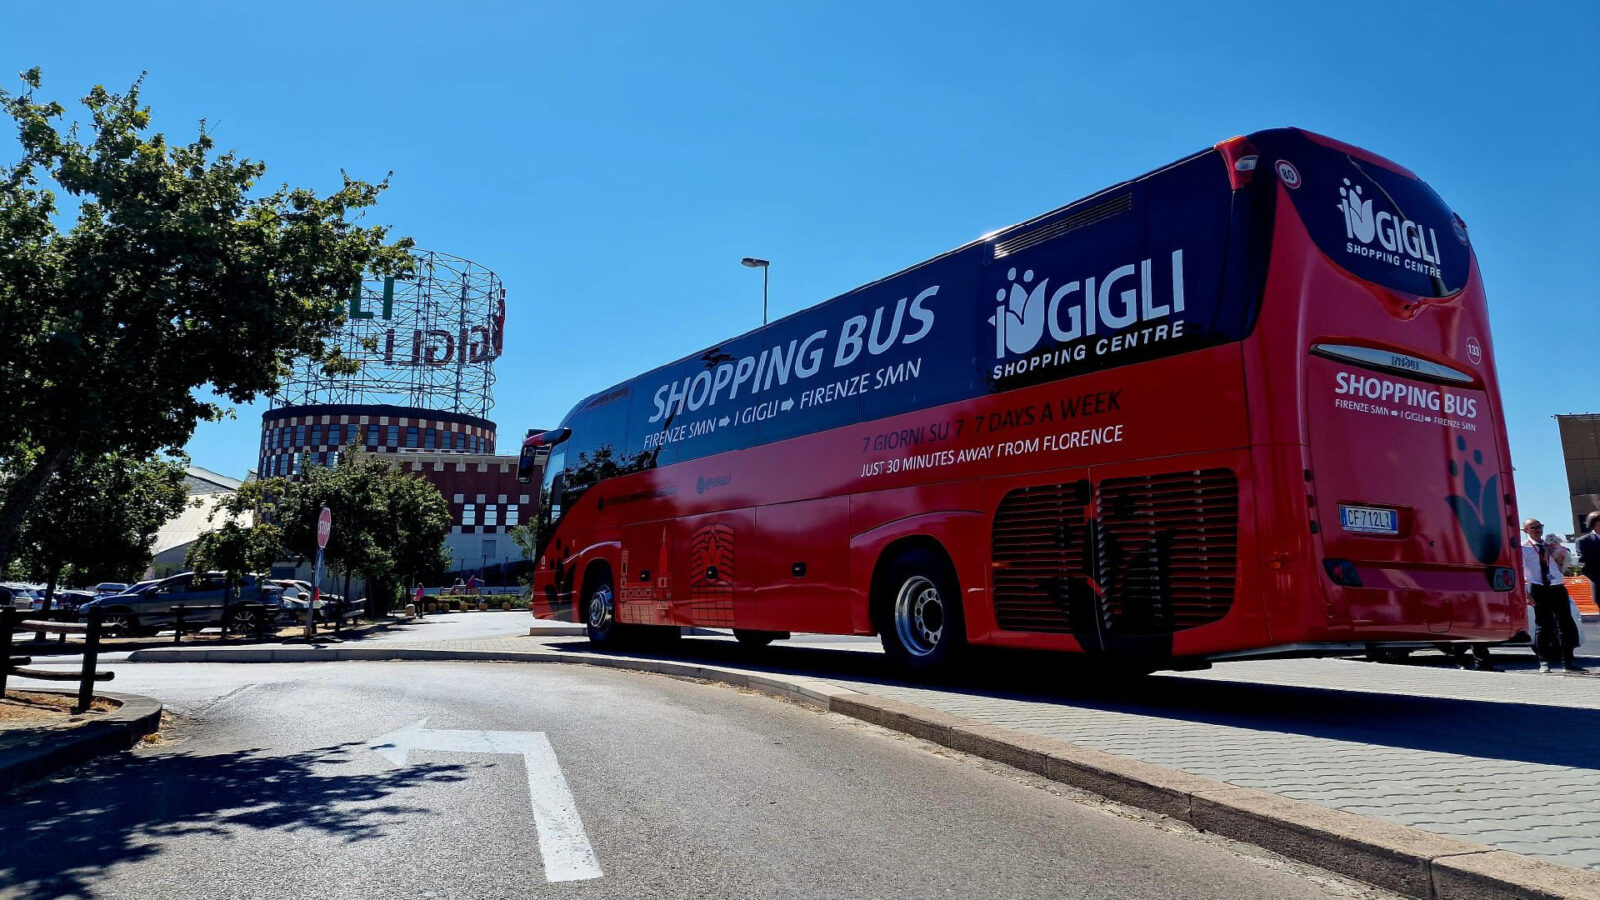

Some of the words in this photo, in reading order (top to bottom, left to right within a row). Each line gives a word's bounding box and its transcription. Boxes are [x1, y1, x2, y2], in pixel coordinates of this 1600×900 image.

[1282, 168, 1294, 181] 80
[1346, 242, 1400, 266] SHOPPING
[1404, 258, 1441, 279] CENTRE
[1376, 211, 1440, 265] GIGLI
[1048, 249, 1185, 342] GIGLI
[648, 329, 828, 423] SHOPPING
[833, 285, 940, 368] BUS
[992, 344, 1086, 380] SHOPPING
[1095, 320, 1186, 356] CENTRE
[1467, 344, 1480, 357] 133
[643, 426, 686, 450] FIRENZE
[688, 417, 716, 440] SMN
[742, 400, 779, 425] GIGLI
[800, 373, 871, 410] FIRENZE
[874, 358, 922, 390] SMN
[862, 436, 871, 453] 7
[874, 426, 924, 452] GIORNI
[929, 422, 950, 441] SU
[956, 419, 964, 438] 7
[975, 416, 984, 434] 7
[988, 406, 1035, 432] DAYS
[1039, 402, 1054, 424] A
[1060, 390, 1122, 420] WEEK
[1334, 372, 1440, 411] SHOPPING
[1443, 393, 1477, 419] BUS
[1335, 398, 1370, 413] FIRENZE
[1370, 404, 1389, 416] SMN
[1405, 411, 1424, 423] GIGLI
[1434, 416, 1461, 429] FIRENZE
[1462, 422, 1476, 432] SMN
[860, 460, 884, 478] JUST
[886, 458, 900, 474] 30
[902, 449, 955, 472] MINUTES
[957, 444, 994, 463] AWAY
[996, 439, 1039, 458] FROM
[1043, 424, 1124, 452] FLORENCE
